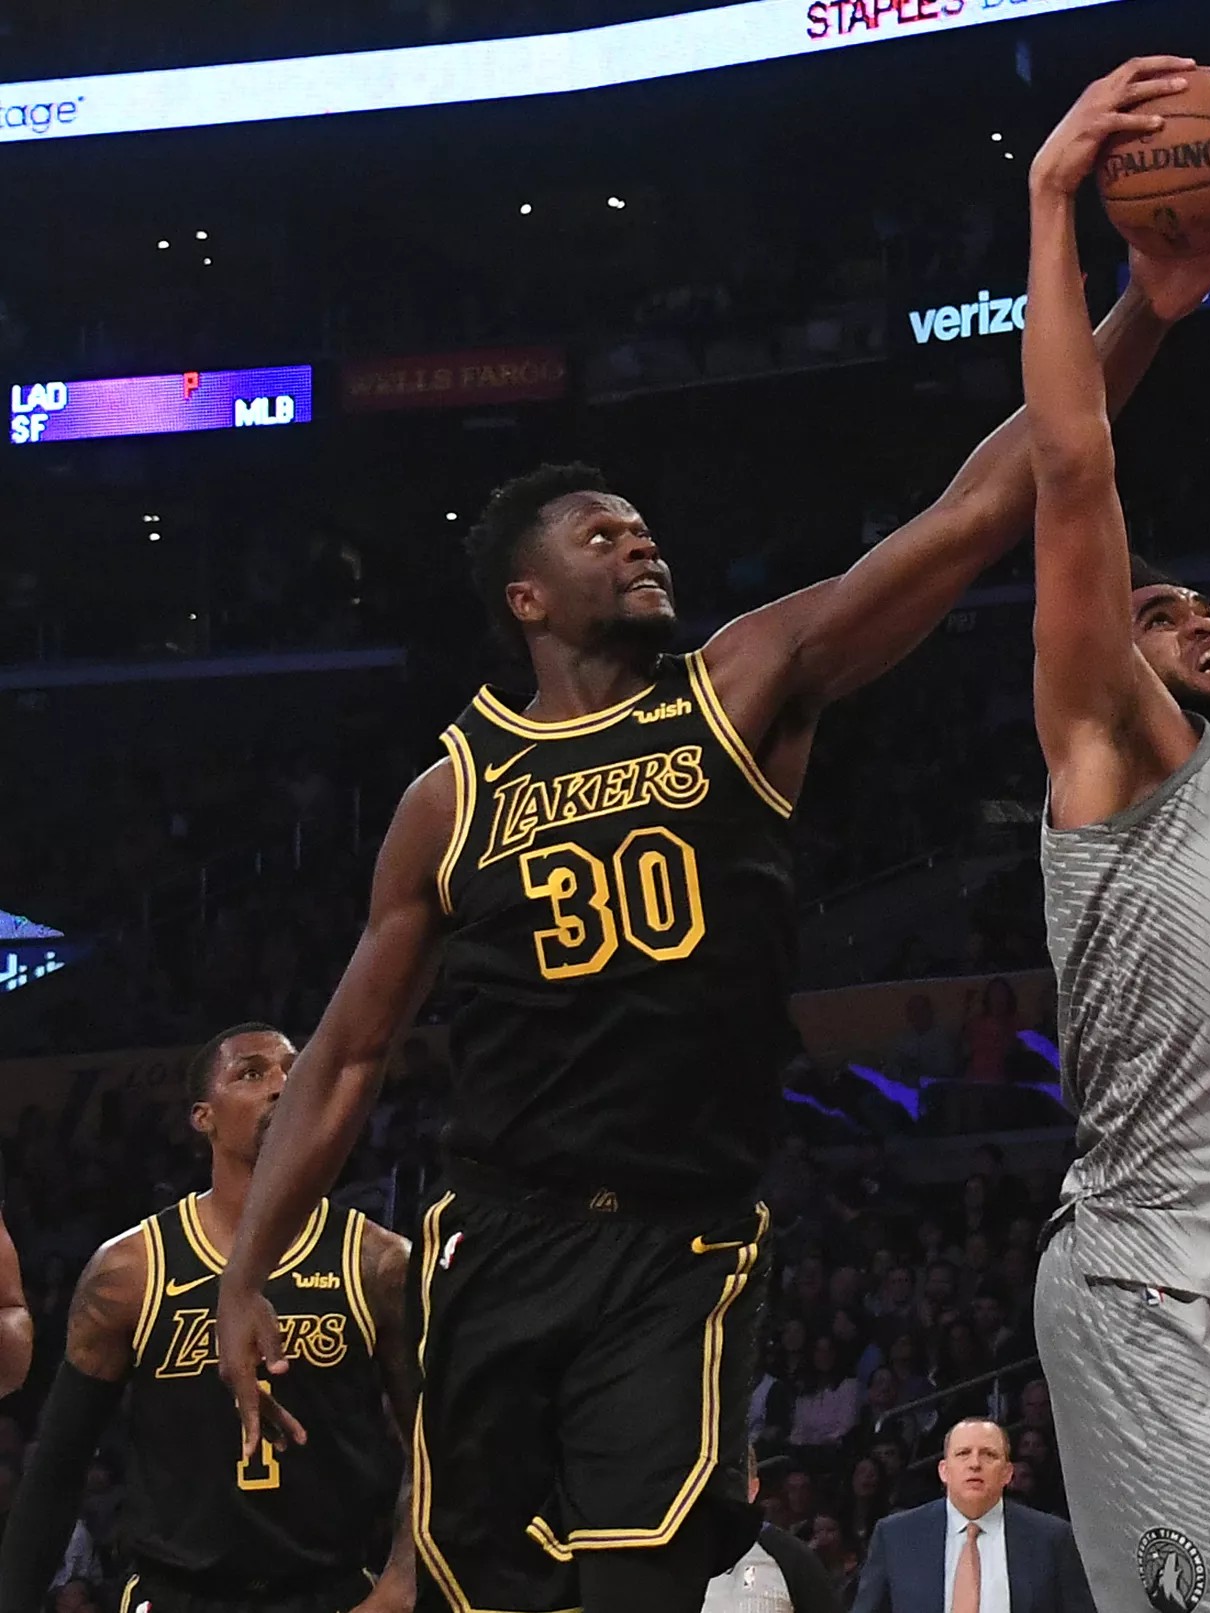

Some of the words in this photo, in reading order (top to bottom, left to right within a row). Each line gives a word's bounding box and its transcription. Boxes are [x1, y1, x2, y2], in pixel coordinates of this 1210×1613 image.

[0, 100, 77, 134] age
[11, 381, 67, 413] LAD
[234, 395, 294, 427] MLB
[11, 413, 49, 444] SF
[632, 698, 693, 725] wish
[478, 745, 710, 871] LAKERS
[519, 826, 706, 980] 30
[292, 1271, 341, 1289] wish
[155, 1307, 349, 1380] LARS
